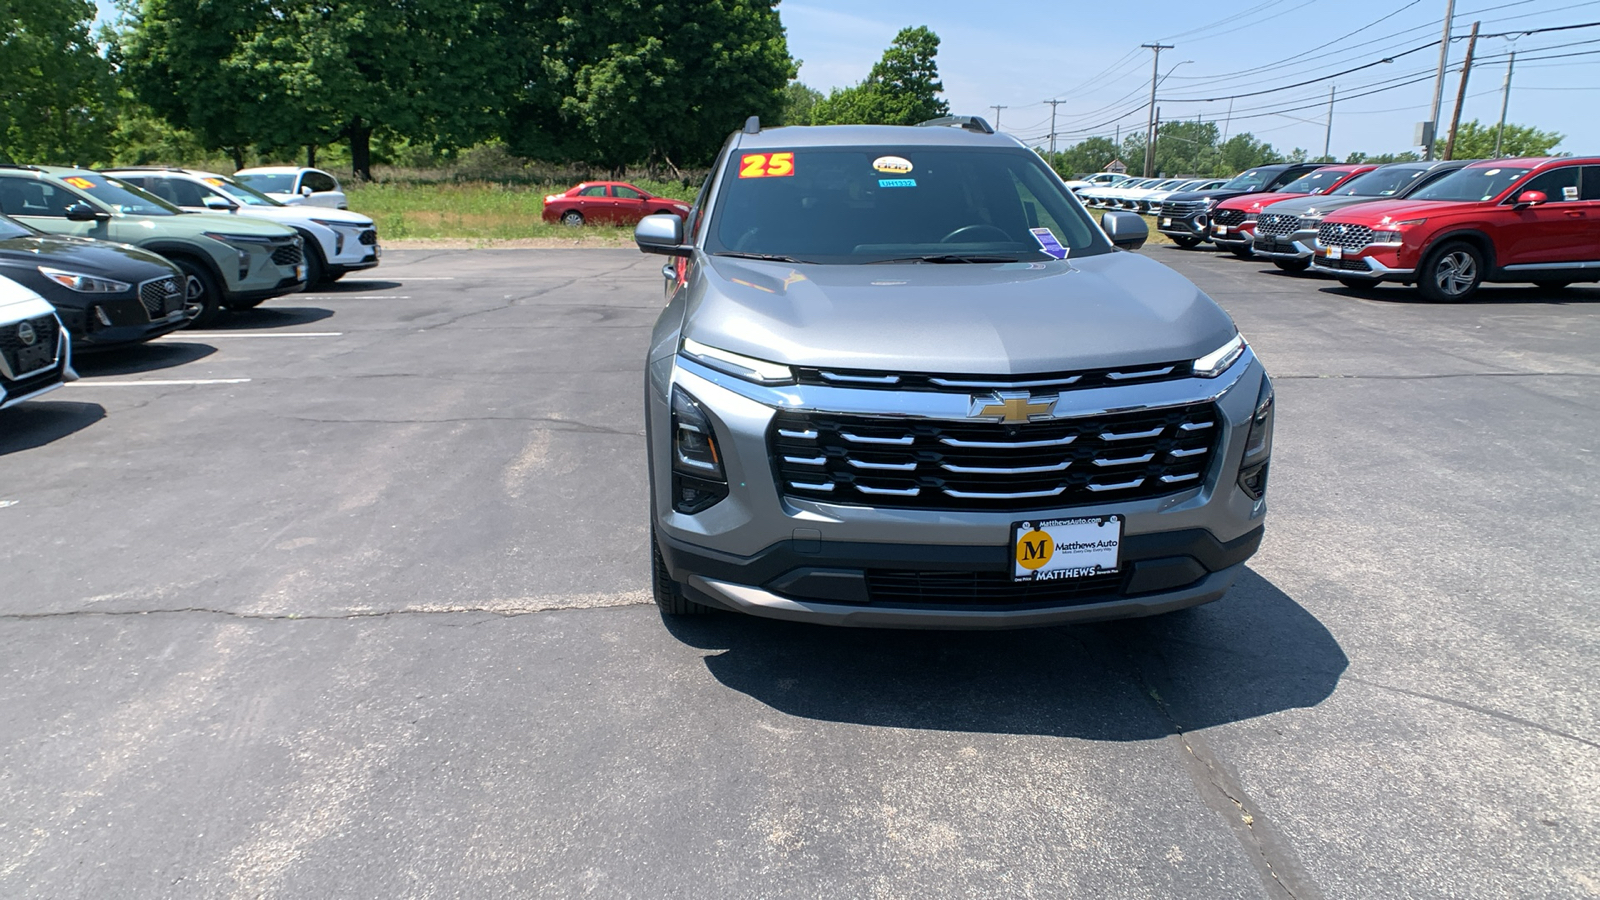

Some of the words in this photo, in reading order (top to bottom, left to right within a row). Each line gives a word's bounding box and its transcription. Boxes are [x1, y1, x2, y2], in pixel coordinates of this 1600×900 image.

[741, 153, 792, 177] 25
[1039, 518, 1101, 528] MatthewsAuto.com
[1022, 540, 1048, 560] M
[1055, 541, 1096, 551] Matthews
[1097, 540, 1117, 548] Auto
[1036, 567, 1095, 581] MATTHEWS
